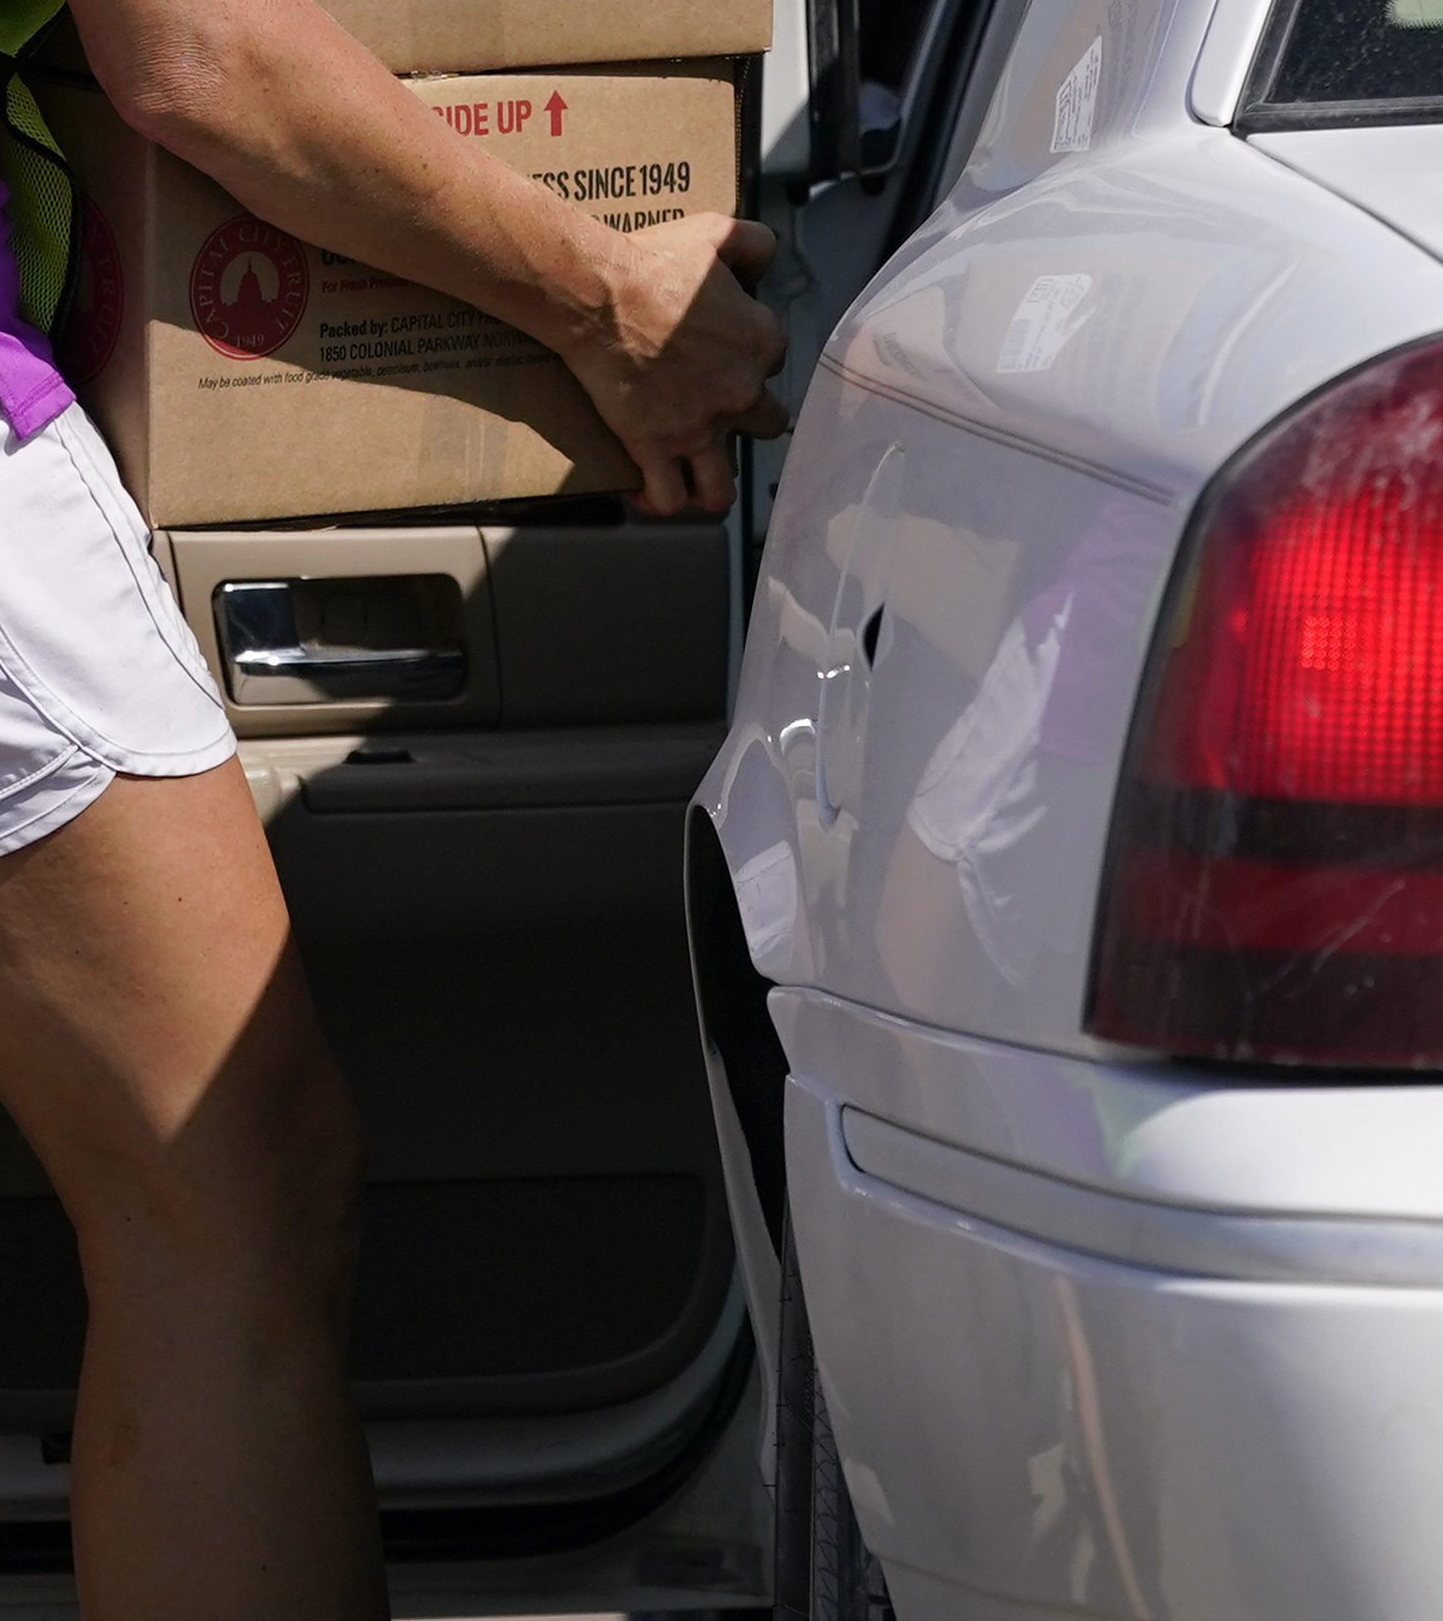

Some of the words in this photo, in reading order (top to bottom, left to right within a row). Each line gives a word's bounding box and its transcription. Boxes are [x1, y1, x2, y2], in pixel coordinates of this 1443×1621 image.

[497, 100, 532, 134] UP
[574, 166, 636, 201] SINCE
[639, 161, 690, 196] 1949
[319, 320, 367, 339] Packed
[370, 318, 388, 336] by:
[391, 314, 442, 334] CAPITAL
[448, 311, 476, 328] CITY
[319, 345, 347, 362] 1850
[349, 340, 414, 360] COLONIAL
[417, 334, 481, 354] PARKWAY
[198, 377, 218, 390] May
[219, 377, 231, 388] be
[232, 376, 261, 387] coated
[263, 374, 283, 385] with
[284, 372, 304, 383] food
